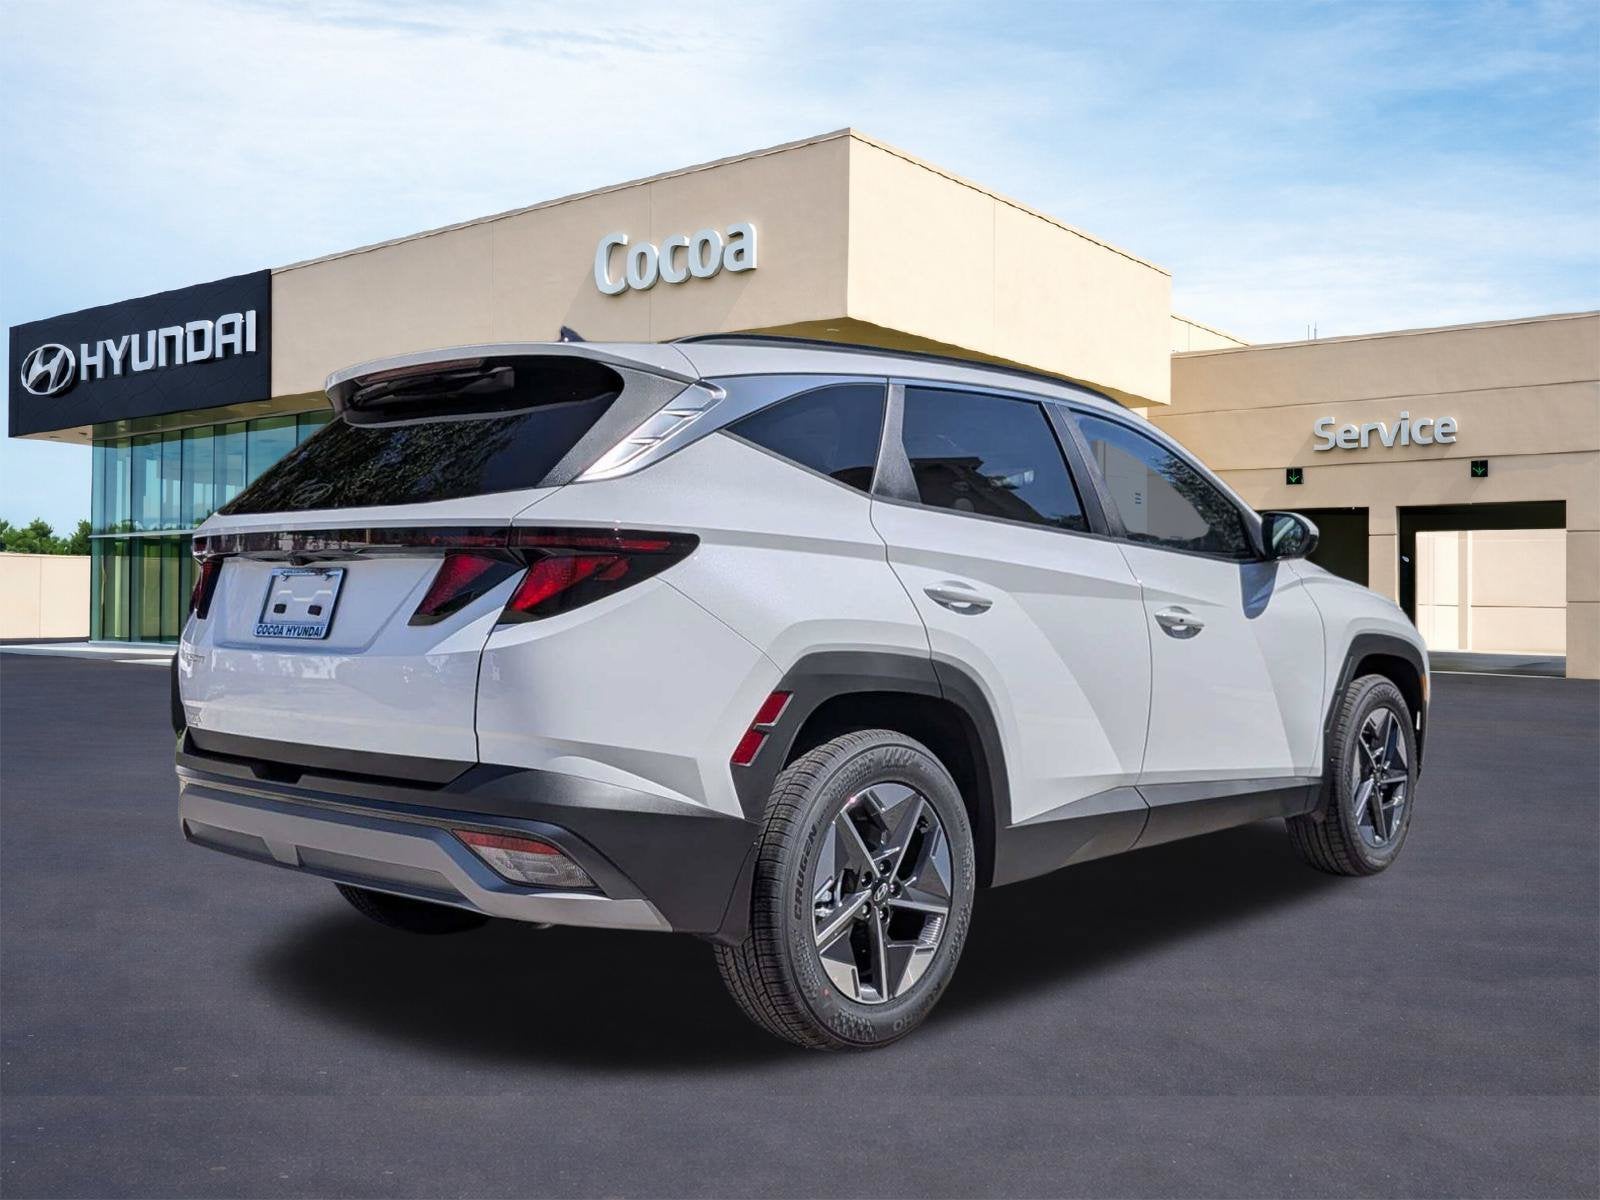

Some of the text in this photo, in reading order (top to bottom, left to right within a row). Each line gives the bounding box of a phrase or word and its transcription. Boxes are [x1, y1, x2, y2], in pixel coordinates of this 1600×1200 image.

[594, 222, 758, 295] Cocoa
[80, 310, 257, 381] HYUNDAI
[1313, 411, 1458, 451] Service
[256, 624, 324, 637] COCOA HYUNDAI
[794, 824, 817, 920] CRUGEN
